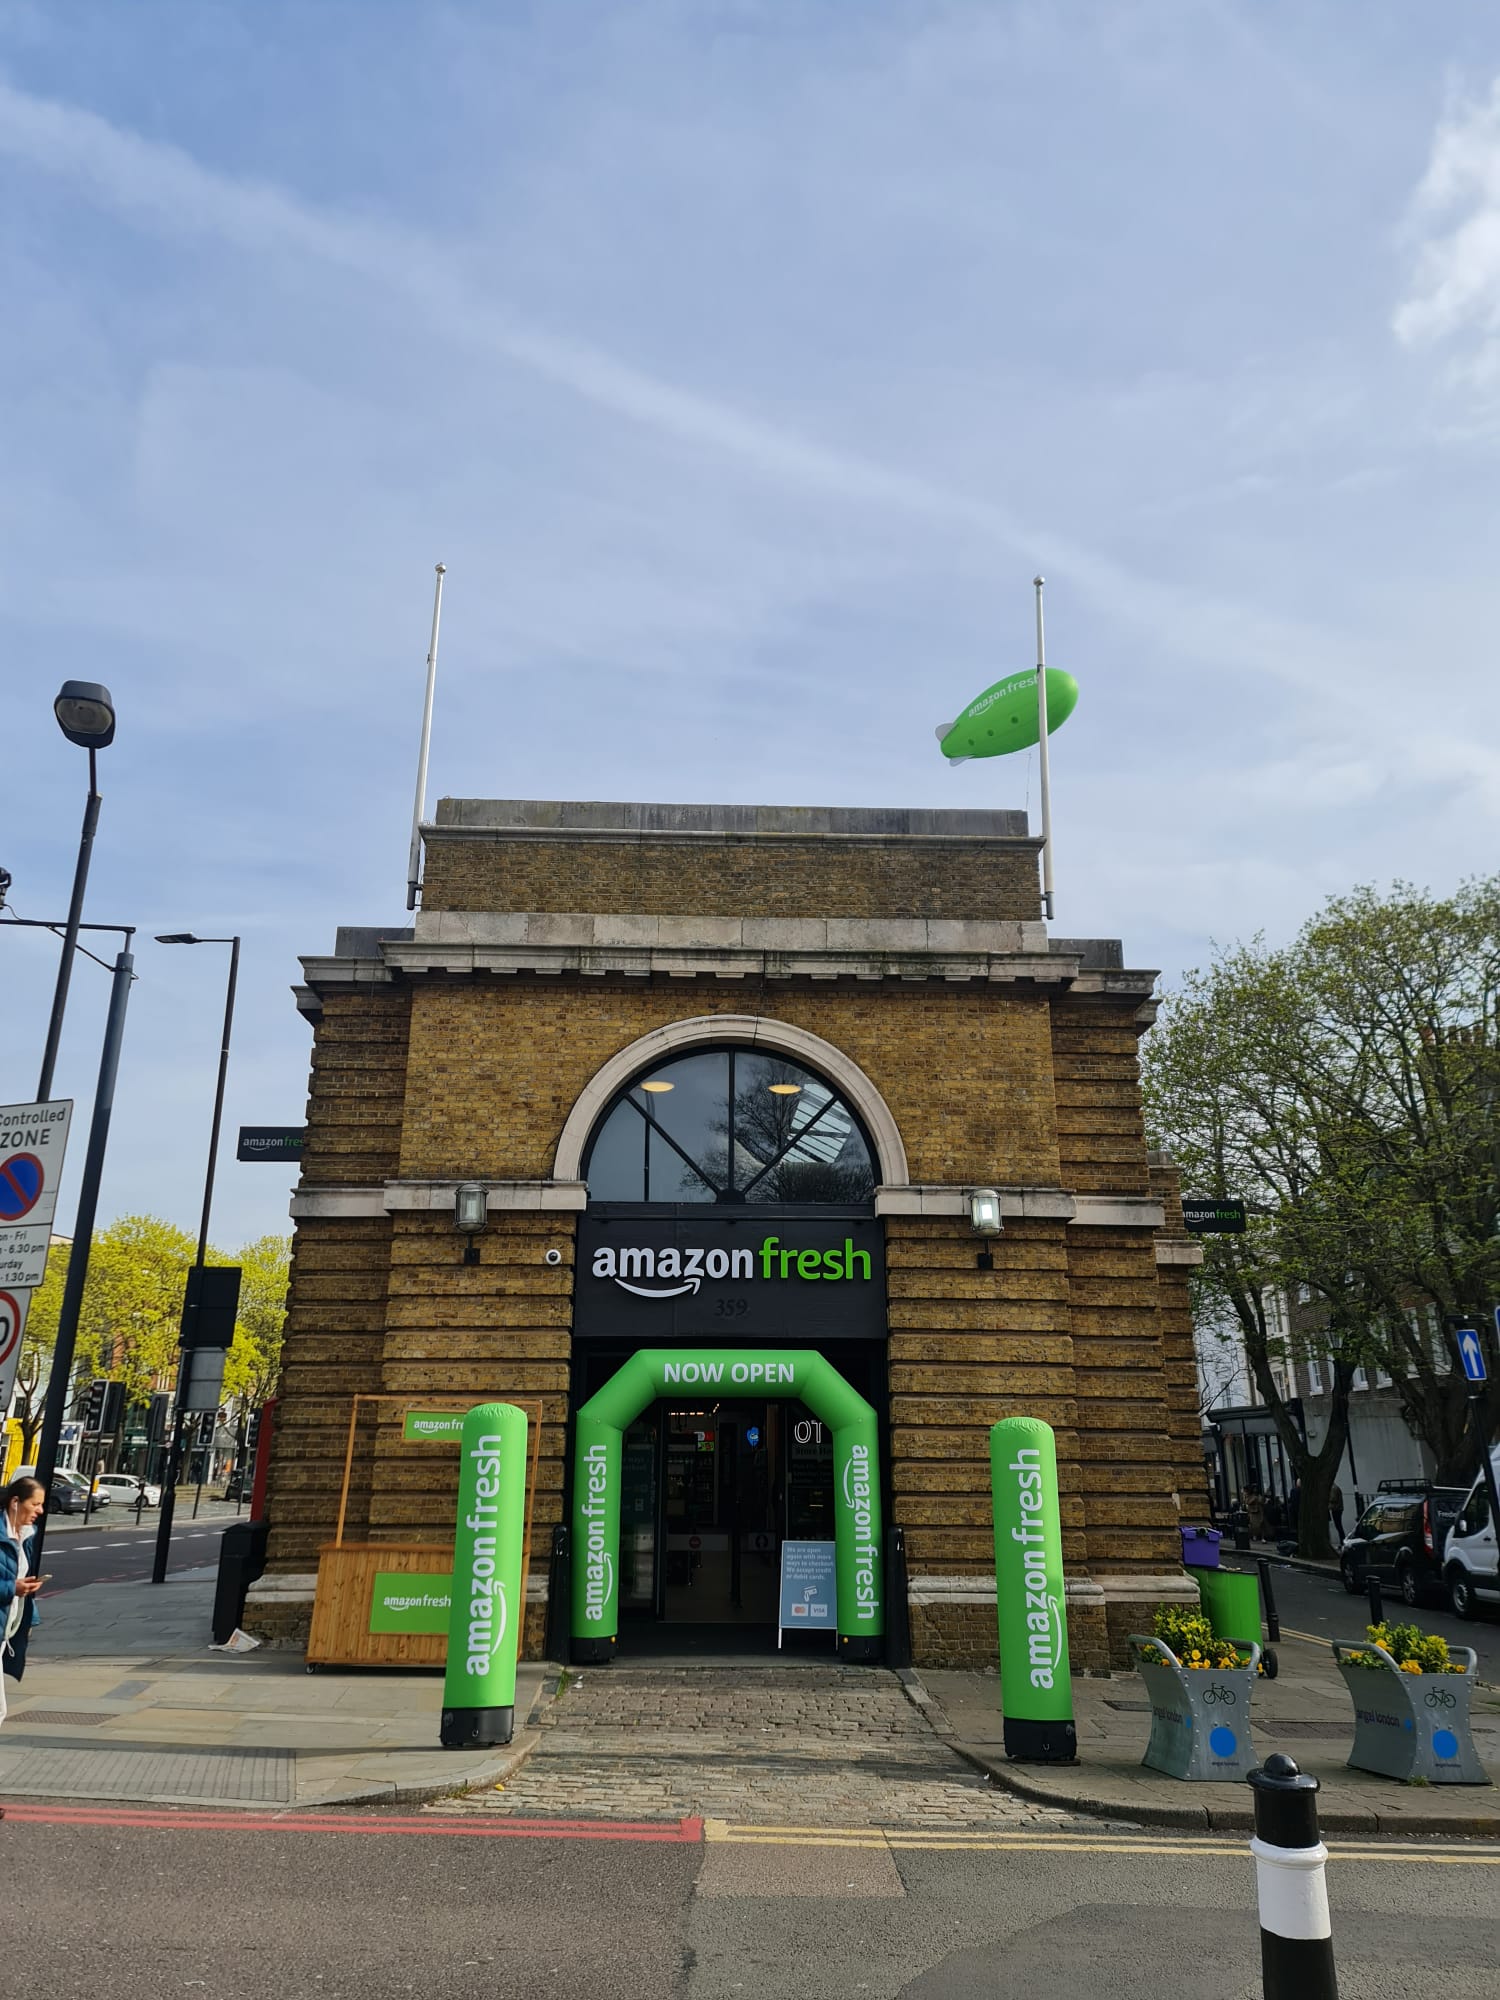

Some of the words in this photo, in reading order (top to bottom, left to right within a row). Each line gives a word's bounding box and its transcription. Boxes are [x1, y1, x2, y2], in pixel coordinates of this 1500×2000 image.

[968, 688, 1006, 718] amazon
[0, 1128, 51, 1149] ZONE
[243, 1138, 284, 1148] amazon
[283, 1136, 305, 1147] fres
[1183, 1210, 1216, 1220] mazon
[1216, 1209, 1241, 1219] fresh
[592, 1247, 754, 1281] amazon
[758, 1237, 872, 1281] fresh
[713, 1298, 748, 1317] 359
[663, 1363, 725, 1384] NOW
[730, 1363, 795, 1384] OPEN
[413, 1420, 450, 1431] amazon
[466, 1435, 502, 1533] fresh
[582, 1444, 608, 1518] fresh
[848, 1444, 871, 1541] amazon
[1009, 1448, 1045, 1546] fresh
[585, 1520, 608, 1622] amazon
[855, 1543, 881, 1620] fresh
[383, 1596, 422, 1608] amazon
[422, 1594, 452, 1608] fresh
[466, 1537, 500, 1677] amazon
[1023, 1550, 1057, 1690] amazon
